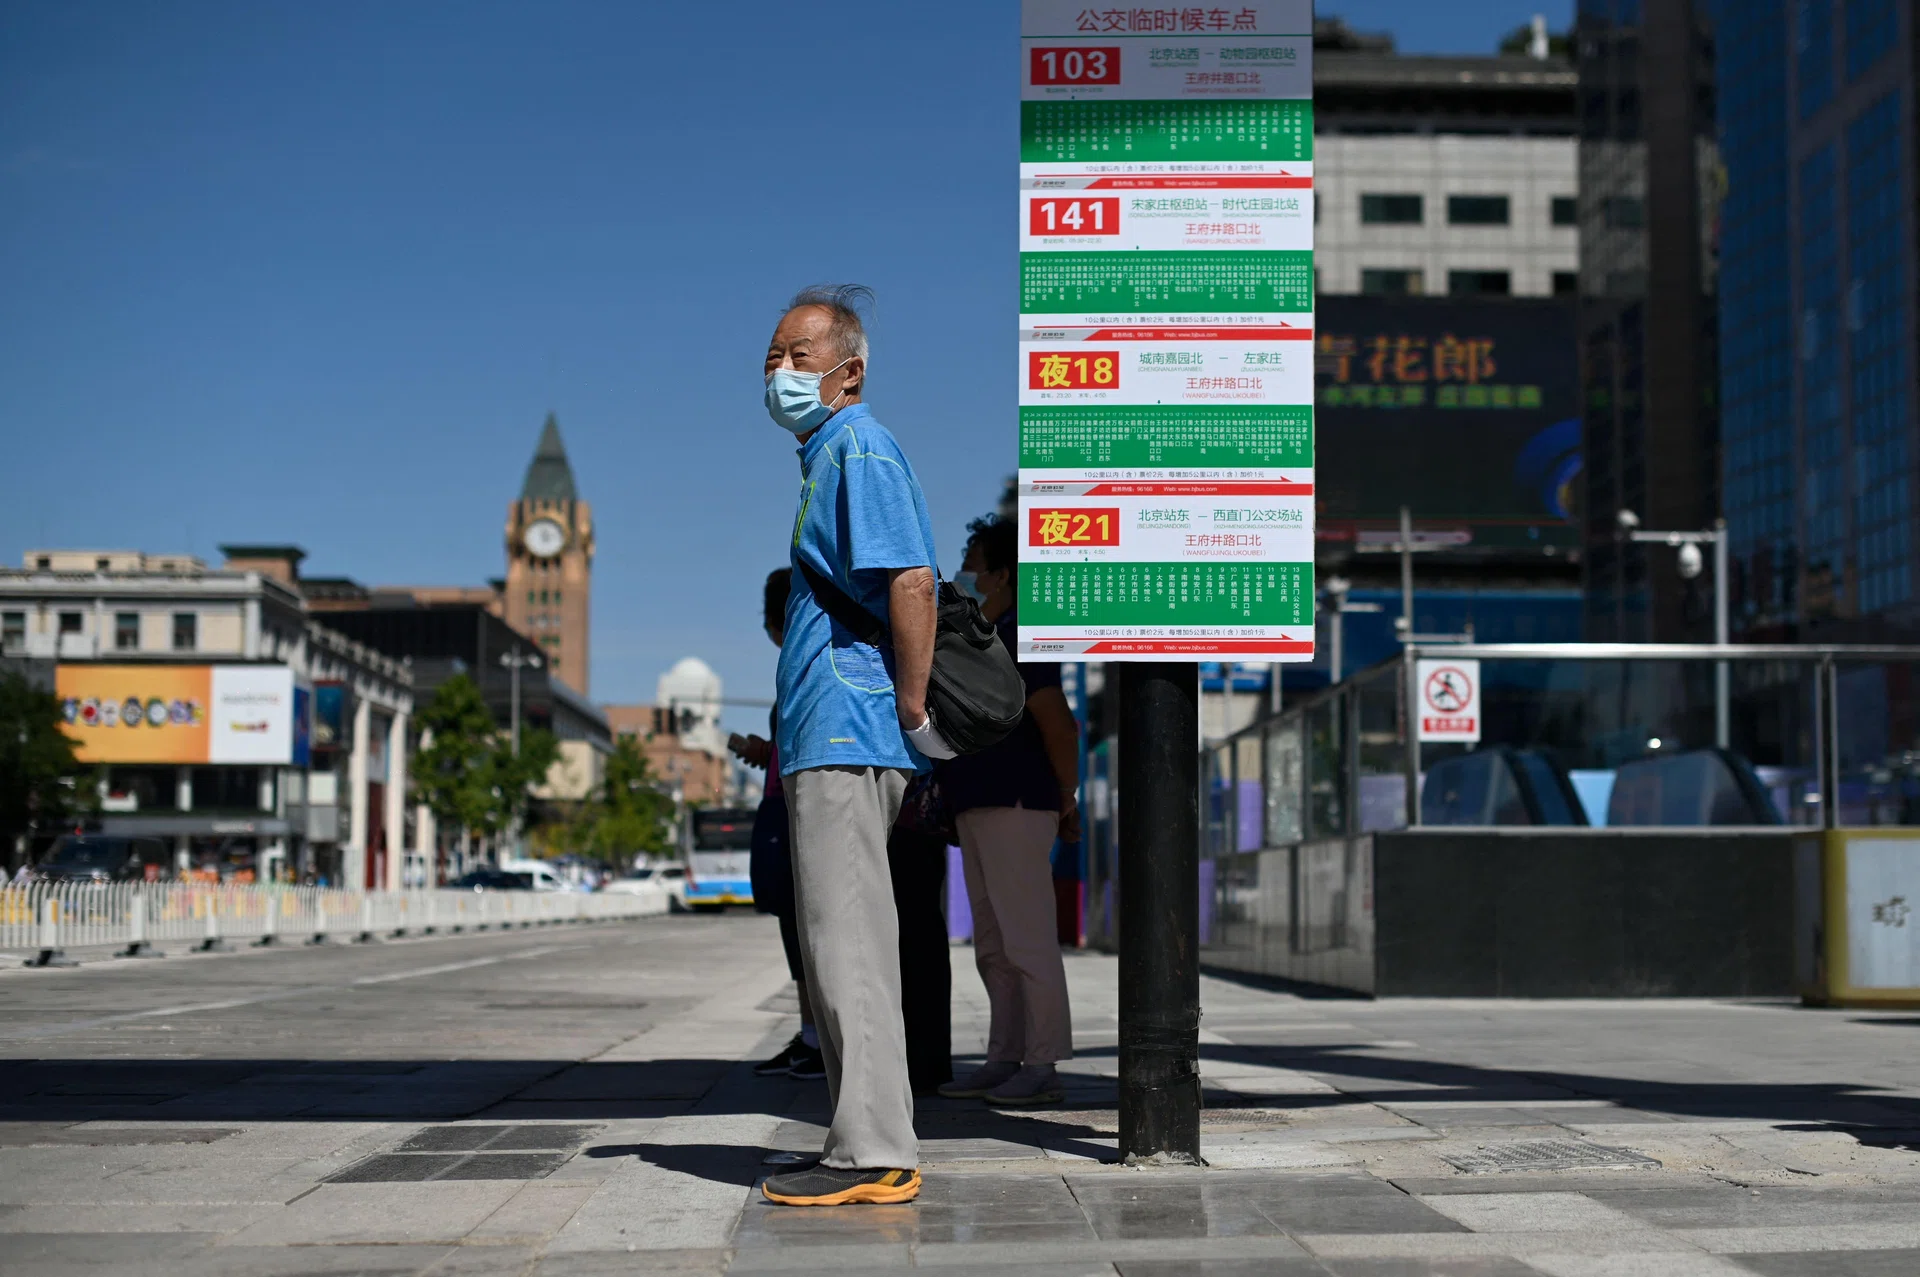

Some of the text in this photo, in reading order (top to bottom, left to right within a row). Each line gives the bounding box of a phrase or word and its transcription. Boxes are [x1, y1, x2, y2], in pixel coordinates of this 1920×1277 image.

[1076, 8, 1258, 32] 公交临时候车点
[1149, 48, 1199, 60] 北京站西
[1042, 51, 1107, 80] 103
[1184, 72, 1261, 84] 王府井路口北
[1132, 198, 1298, 211] 宋家庄枢纽站 时代庄园北站
[1040, 202, 1104, 230] 141
[1185, 223, 1260, 236] 王府井路口北
[1139, 352, 1282, 364] 城南嘉园北 左家庄
[1038, 354, 1113, 388] 夜18
[1186, 377, 1262, 390] 王府井路口北
[1138, 509, 1302, 522] 北京站东 西直门公交场站
[1038, 511, 1110, 544] 夜21
[1185, 534, 1262, 547] 王府井路口北
